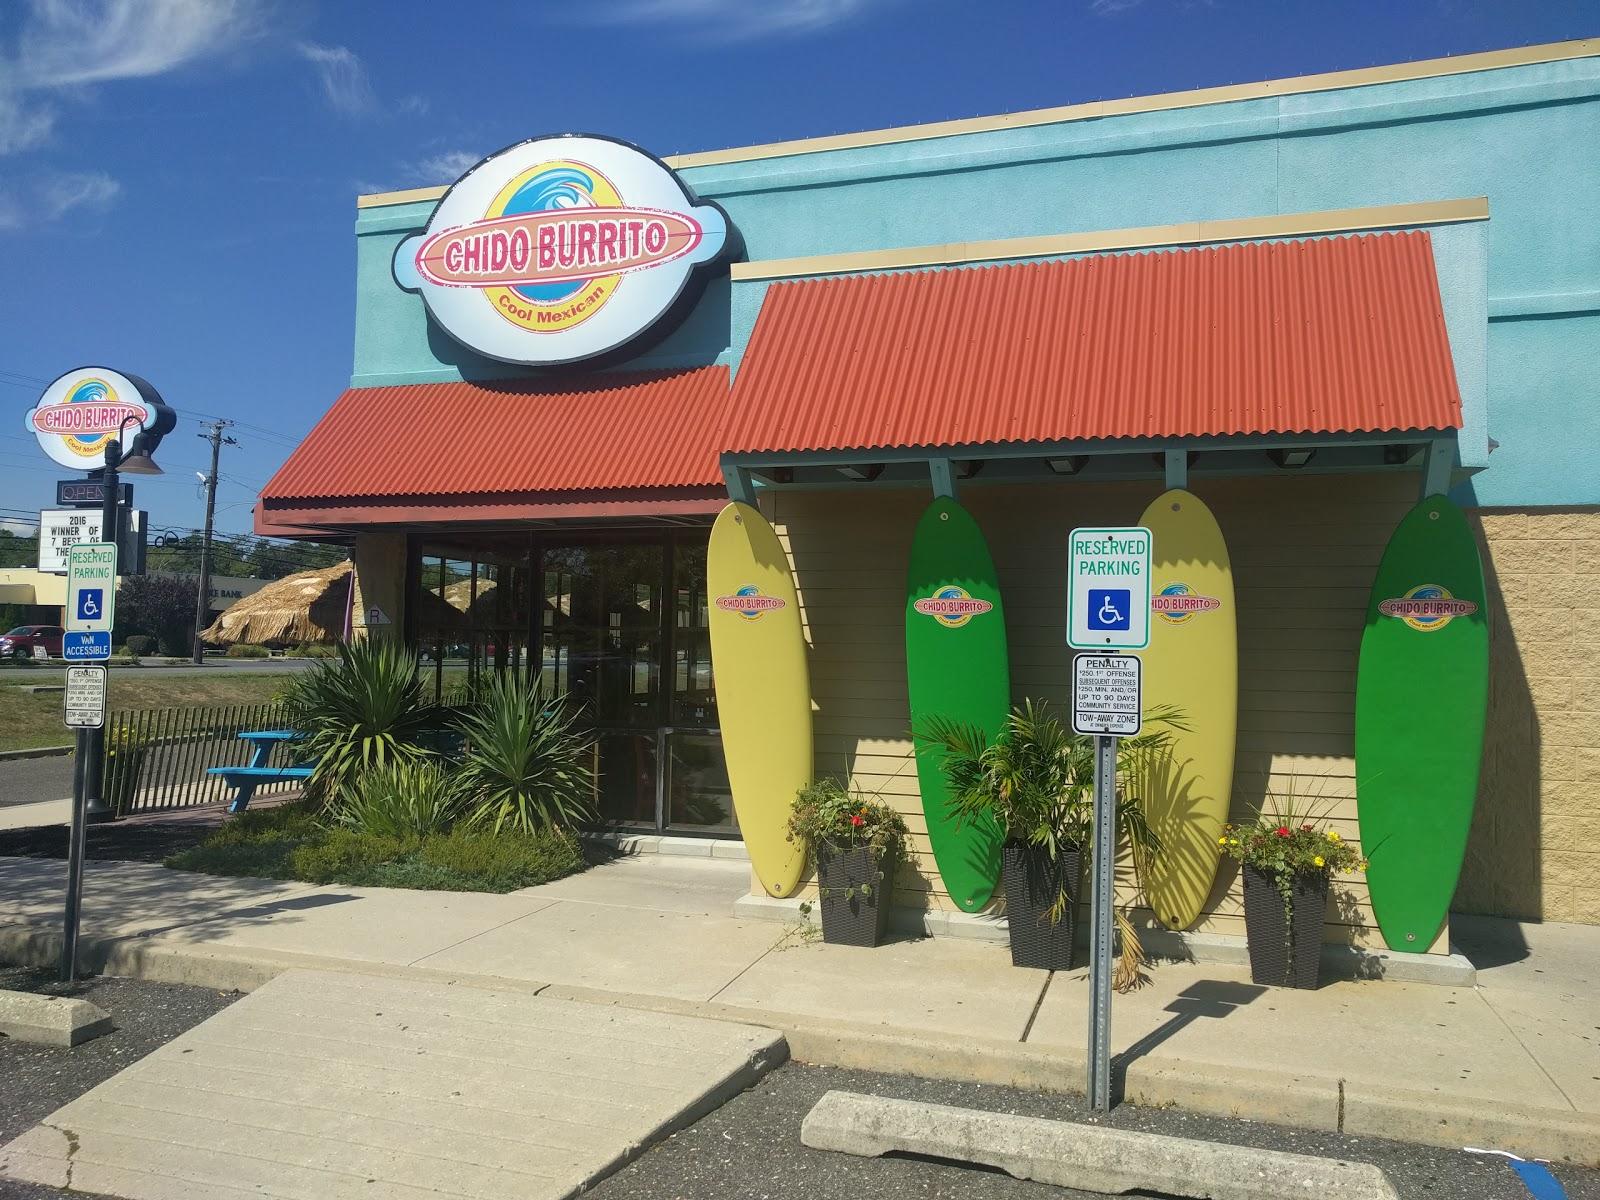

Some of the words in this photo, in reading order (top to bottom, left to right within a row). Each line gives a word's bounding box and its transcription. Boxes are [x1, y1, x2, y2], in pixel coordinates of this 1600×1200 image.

[444, 229, 529, 273] CHIDO
[537, 221, 667, 269] BURRITO
[499, 294, 531, 321] Cool
[537, 285, 604, 323] Mexican
[45, 408, 82, 428] CHIDO
[85, 408, 136, 428] BURRITO
[70, 516, 86, 526] 2016
[51, 526, 80, 536] WINNER
[88, 526, 98, 536] OF
[52, 537, 56, 546] 7
[1076, 540, 1145, 555] RESERVED
[72, 552, 113, 564] RESERVED
[74, 568, 109, 578] PARKING
[1080, 561, 1140, 576] PARKING
[724, 600, 744, 608] CHIDO
[747, 599, 777, 608] BURRITO
[924, 602, 946, 611] CHIDO
[949, 602, 982, 612] BURRITO
[1152, 599, 1169, 609] HIDO
[1172, 599, 1210, 609] BURRITO
[1390, 603, 1420, 613] CHIDO
[1423, 603, 1466, 614] BURRITO
[81, 636, 94, 644] VAN
[66, 645, 108, 656] ACCESSIBLE
[1086, 660, 1128, 668] PENALTY
[1078, 714, 1114, 722] TOW-AWAY
[1117, 715, 1136, 723] ZONE
